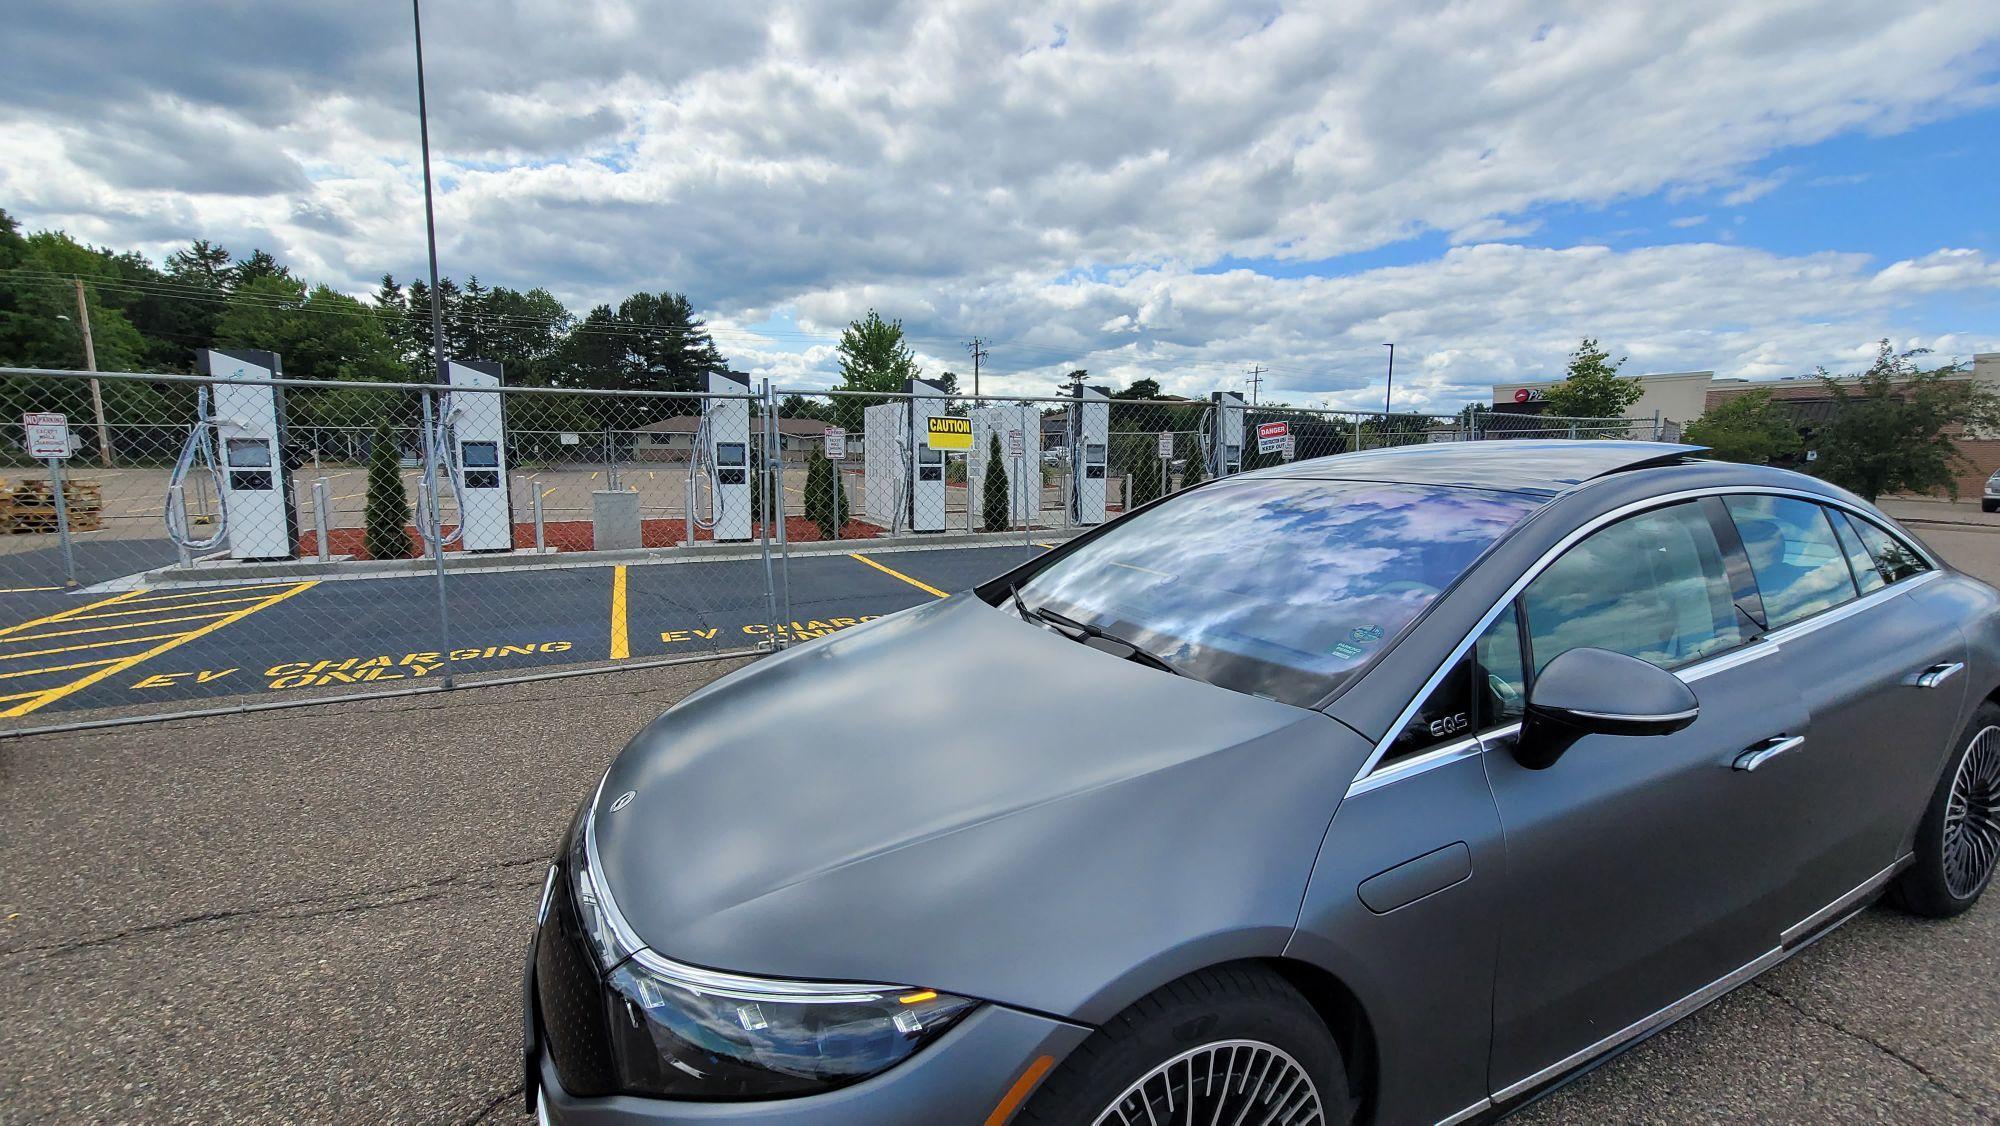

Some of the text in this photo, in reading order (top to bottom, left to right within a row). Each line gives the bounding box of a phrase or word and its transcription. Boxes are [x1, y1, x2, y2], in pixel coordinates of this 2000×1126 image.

[26, 415, 38, 425] NO
[929, 418, 971, 433] CAUTION
[1260, 426, 1285, 435] DANGER
[661, 614, 883, 643] EV CHAR
[129, 641, 573, 690] EV CHARGING
[268, 661, 445, 690] ONLY
[1430, 712, 1468, 737] EQS
